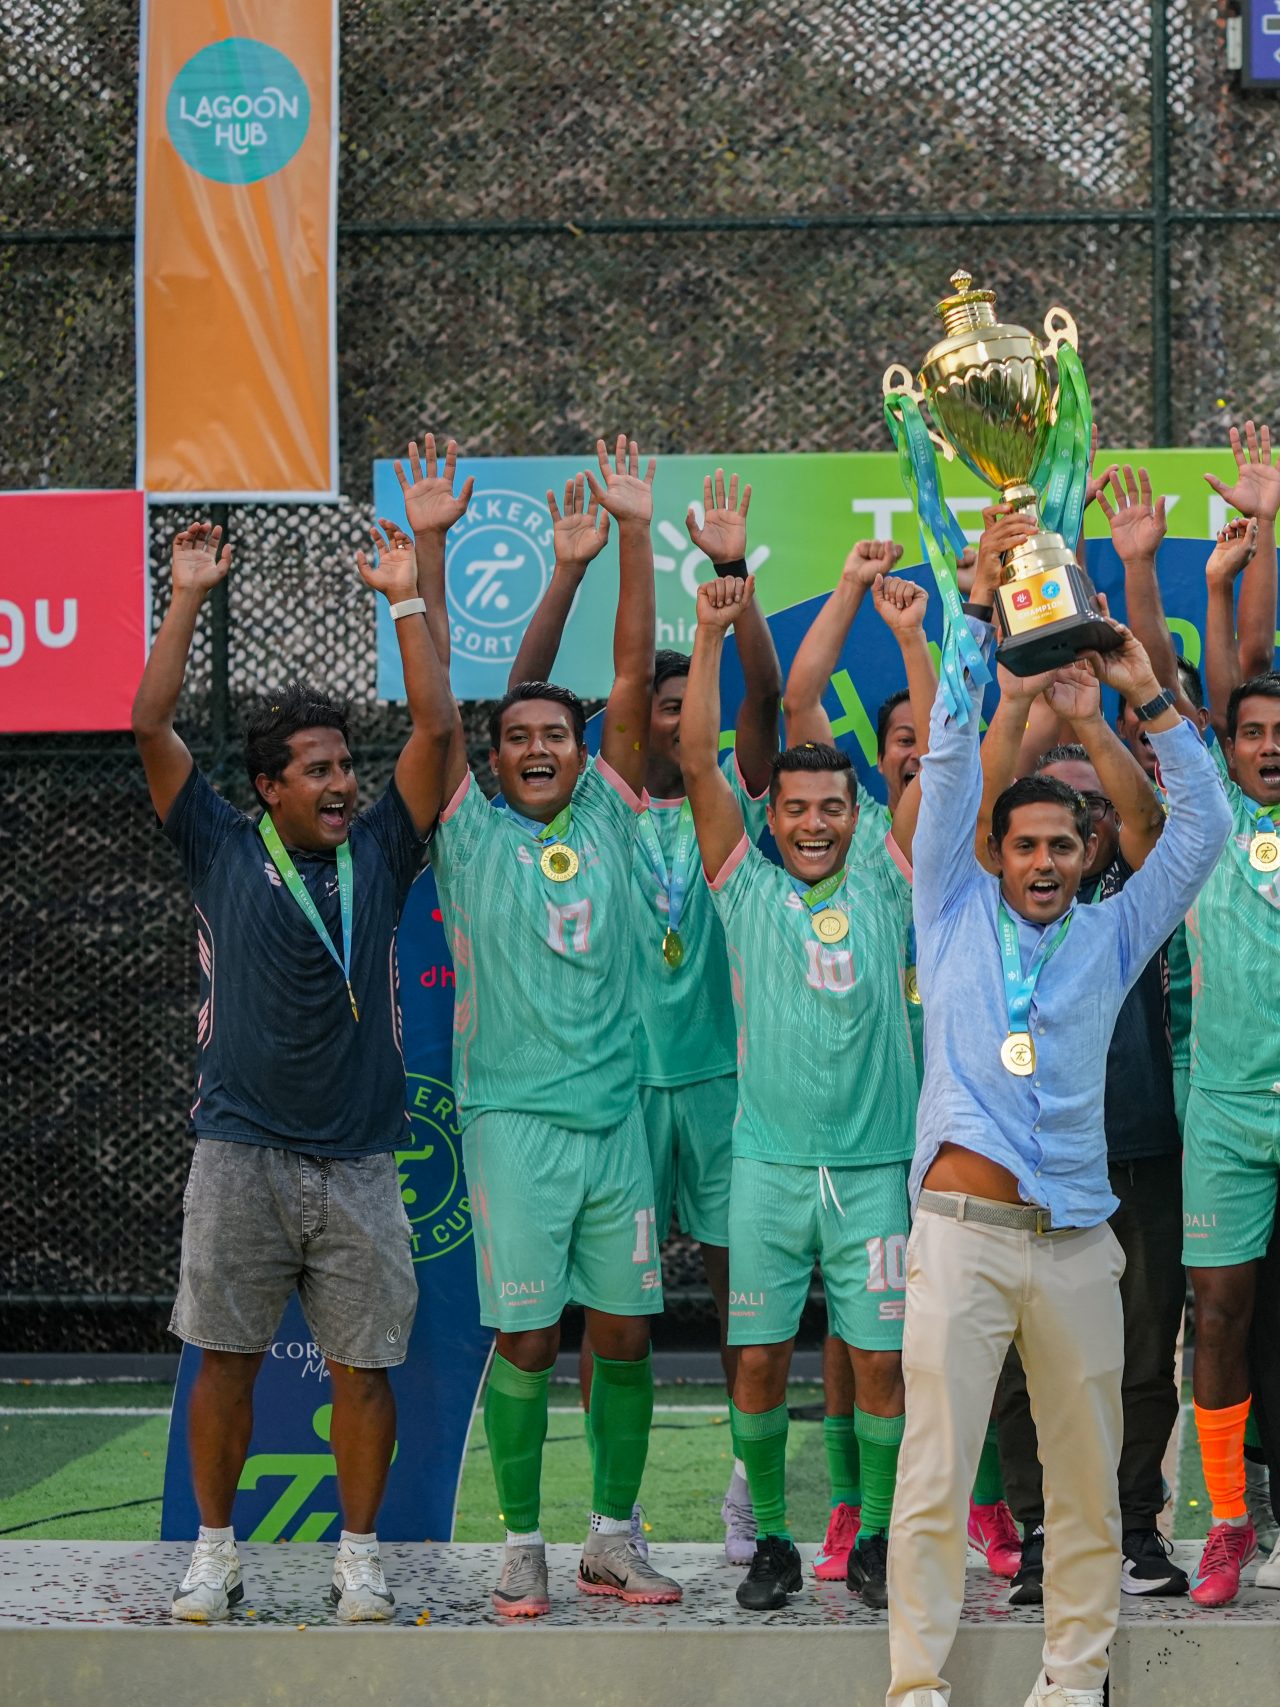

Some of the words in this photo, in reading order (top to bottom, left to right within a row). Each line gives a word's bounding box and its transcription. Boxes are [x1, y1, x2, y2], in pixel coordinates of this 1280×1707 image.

[180, 87, 298, 128] LAGOON
[215, 122, 268, 155] HUB
[453, 624, 513, 654] SORT
[1003, 923, 1013, 957] TEKKERS
[1184, 1212, 1216, 1228] OALI
[866, 1234, 908, 1292] 10
[499, 1279, 545, 1299] JOALI
[729, 1290, 764, 1306] OALI
